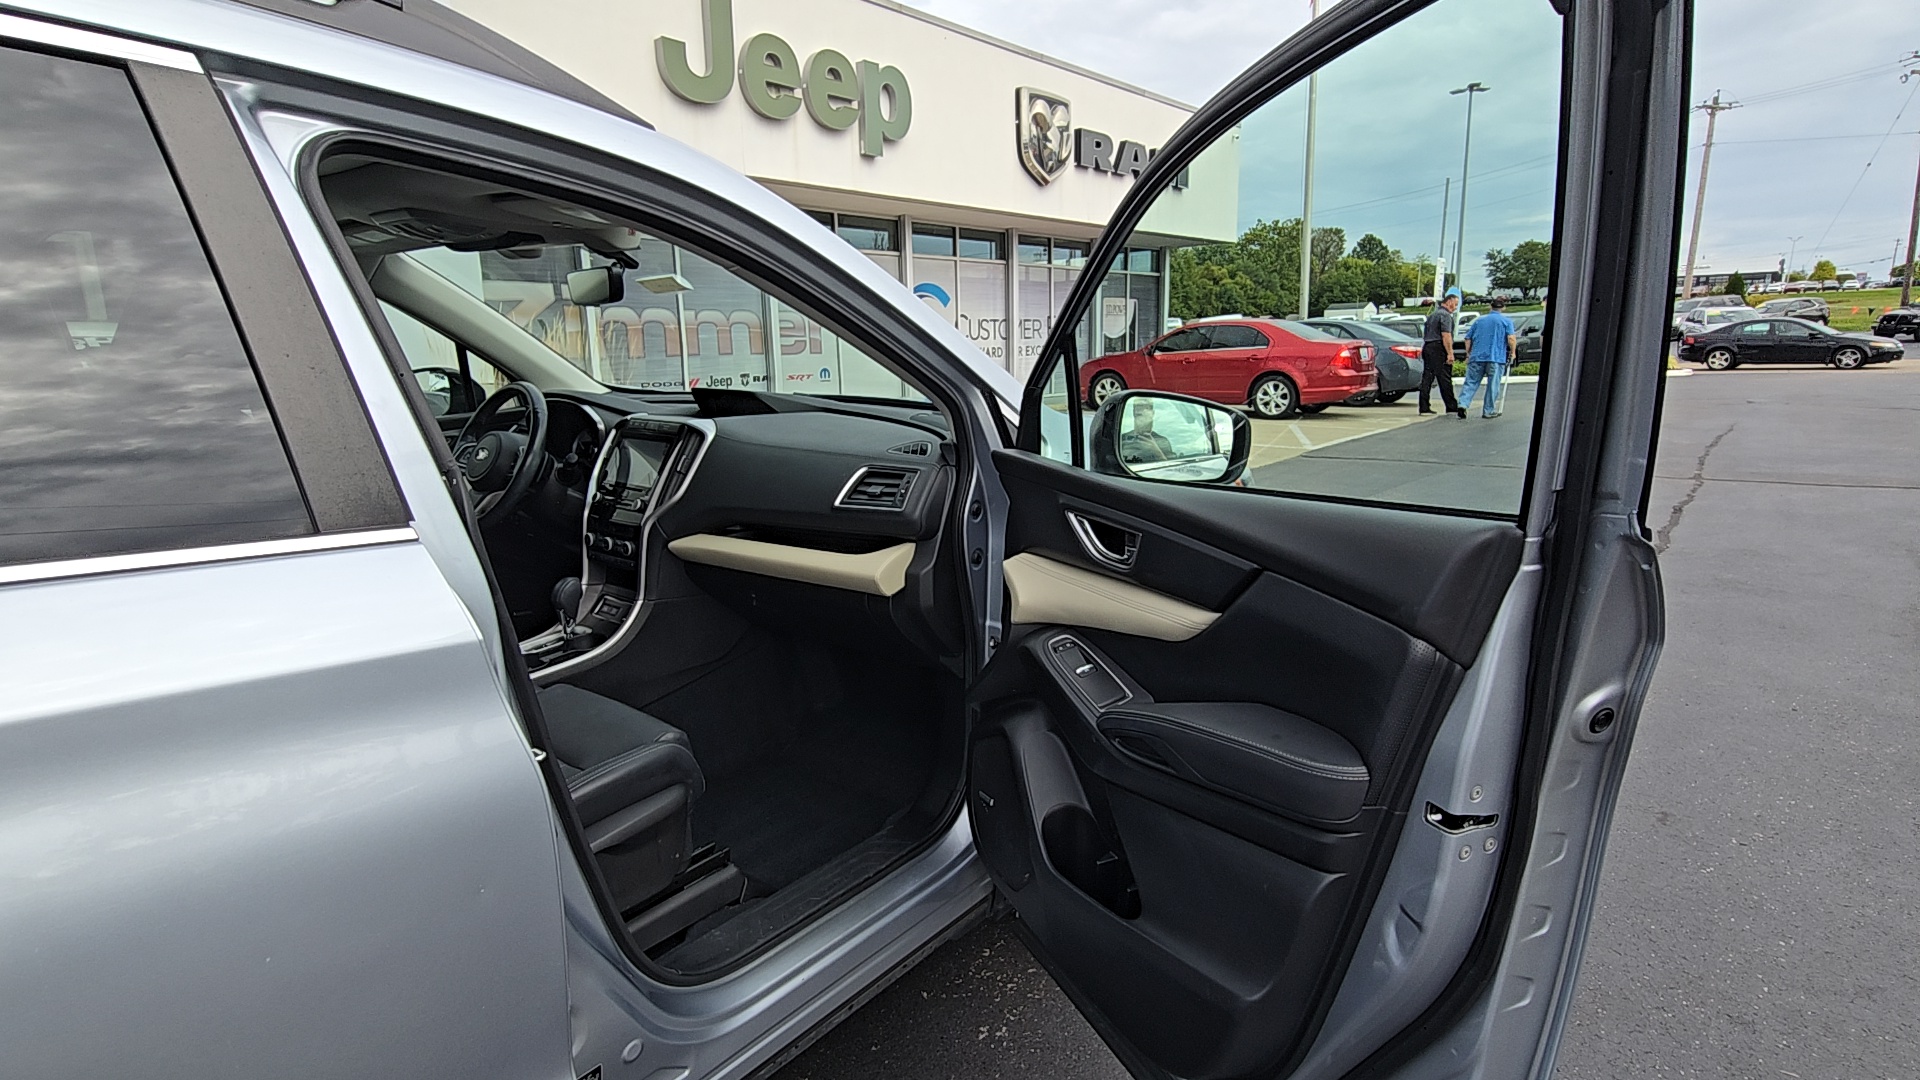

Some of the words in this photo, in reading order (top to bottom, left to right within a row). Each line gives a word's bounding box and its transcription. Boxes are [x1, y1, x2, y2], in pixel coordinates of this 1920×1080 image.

[654, 0, 912, 157] Jeep
[641, 381, 684, 389] DODG
[706, 375, 733, 389] Jeep
[752, 375, 768, 383] RA
[786, 373, 814, 382] SRT
